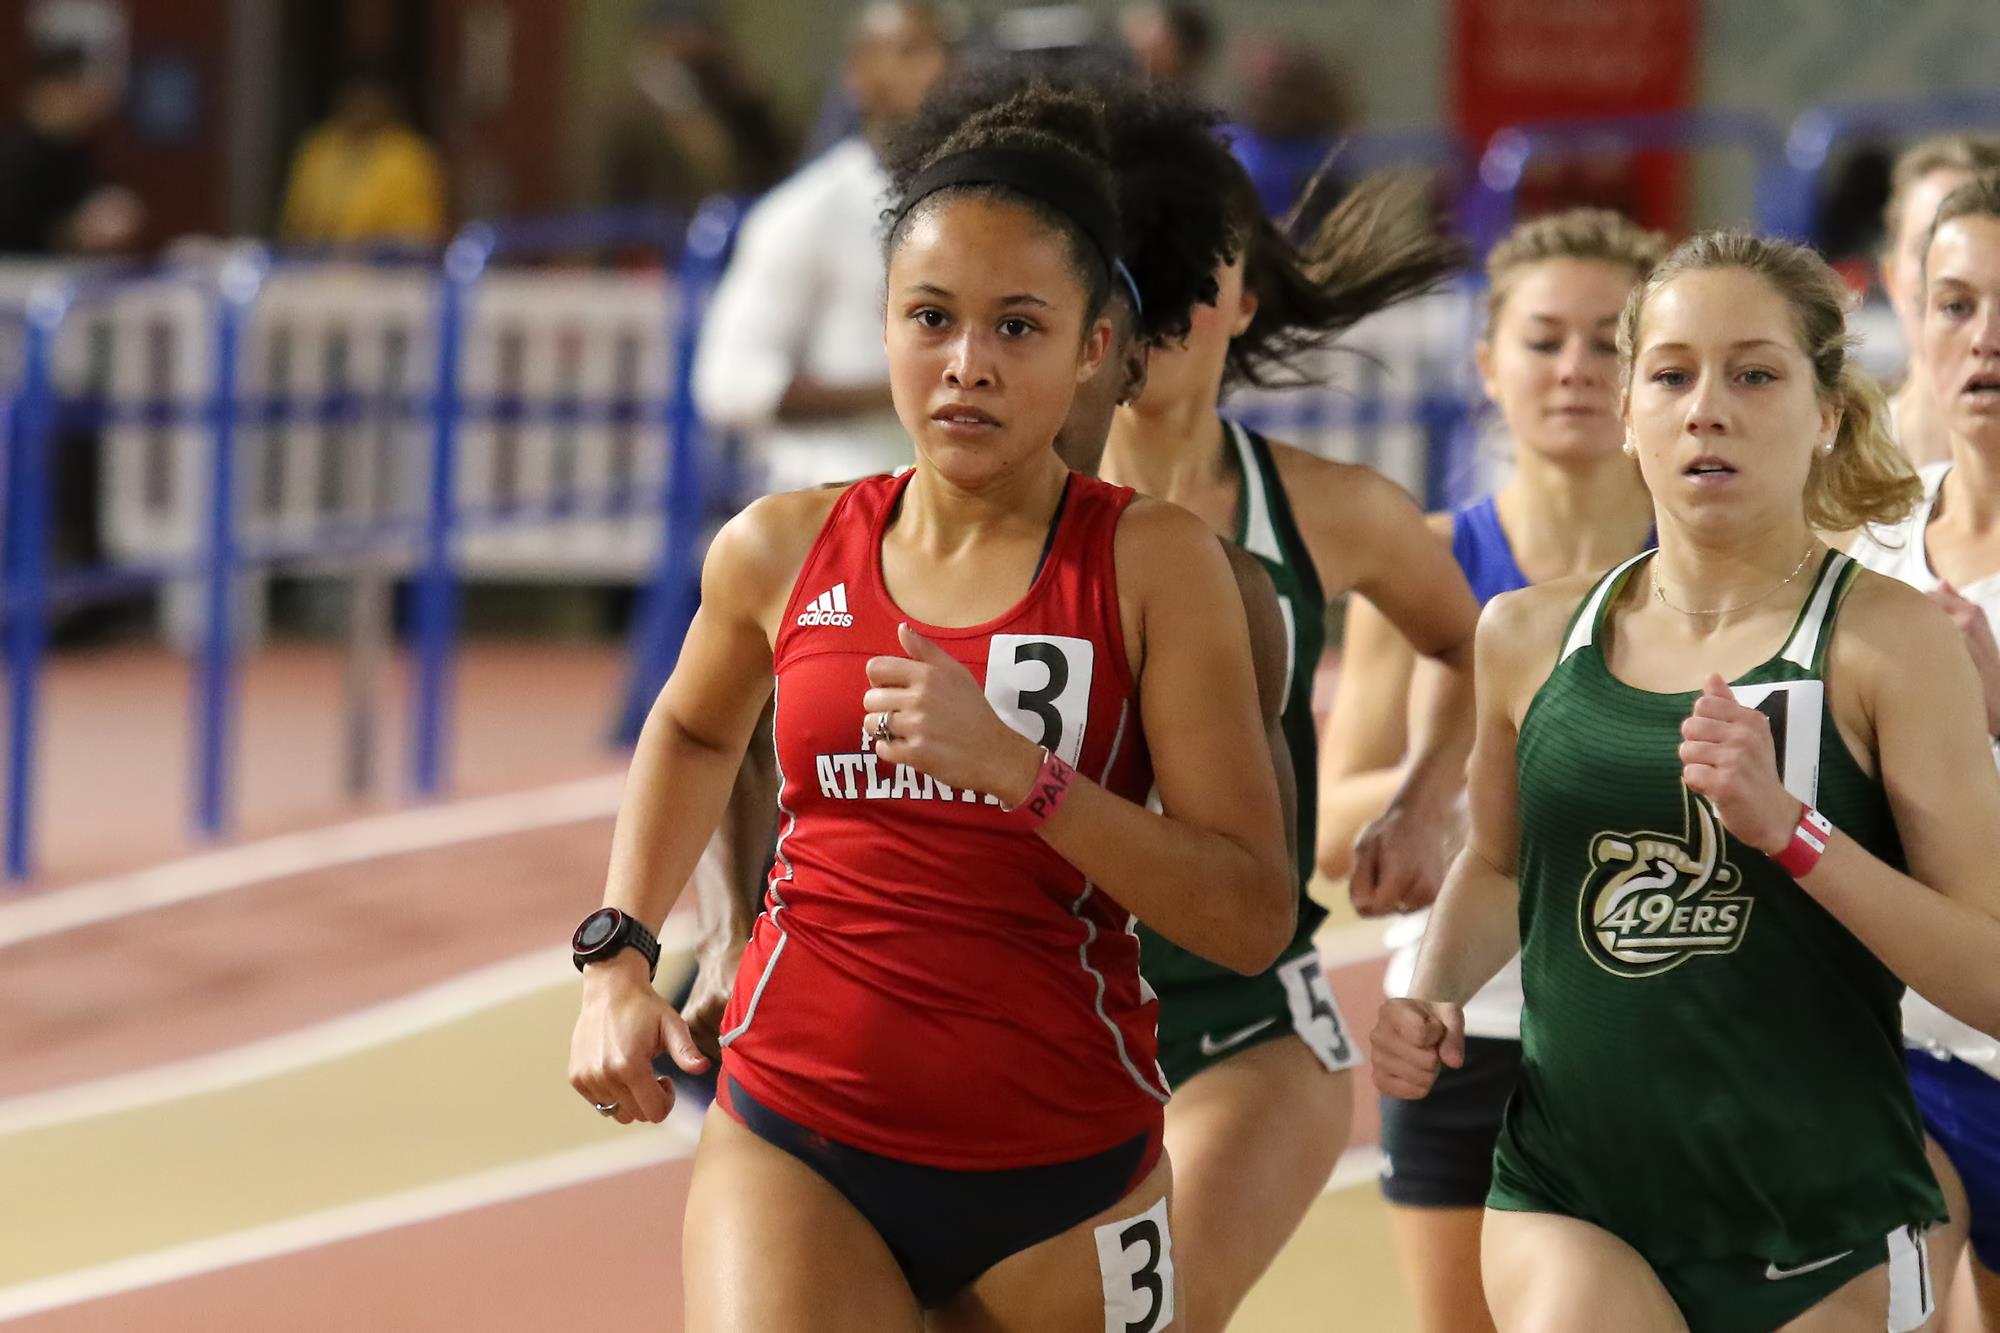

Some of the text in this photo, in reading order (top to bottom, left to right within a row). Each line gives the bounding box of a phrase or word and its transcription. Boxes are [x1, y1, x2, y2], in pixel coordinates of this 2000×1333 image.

[797, 609, 853, 627] adidas
[1014, 641, 1069, 754] 3
[1600, 893, 1741, 935] 49ERS
[1299, 962, 1352, 1063] 5
[1119, 1219, 1163, 1333] 3
